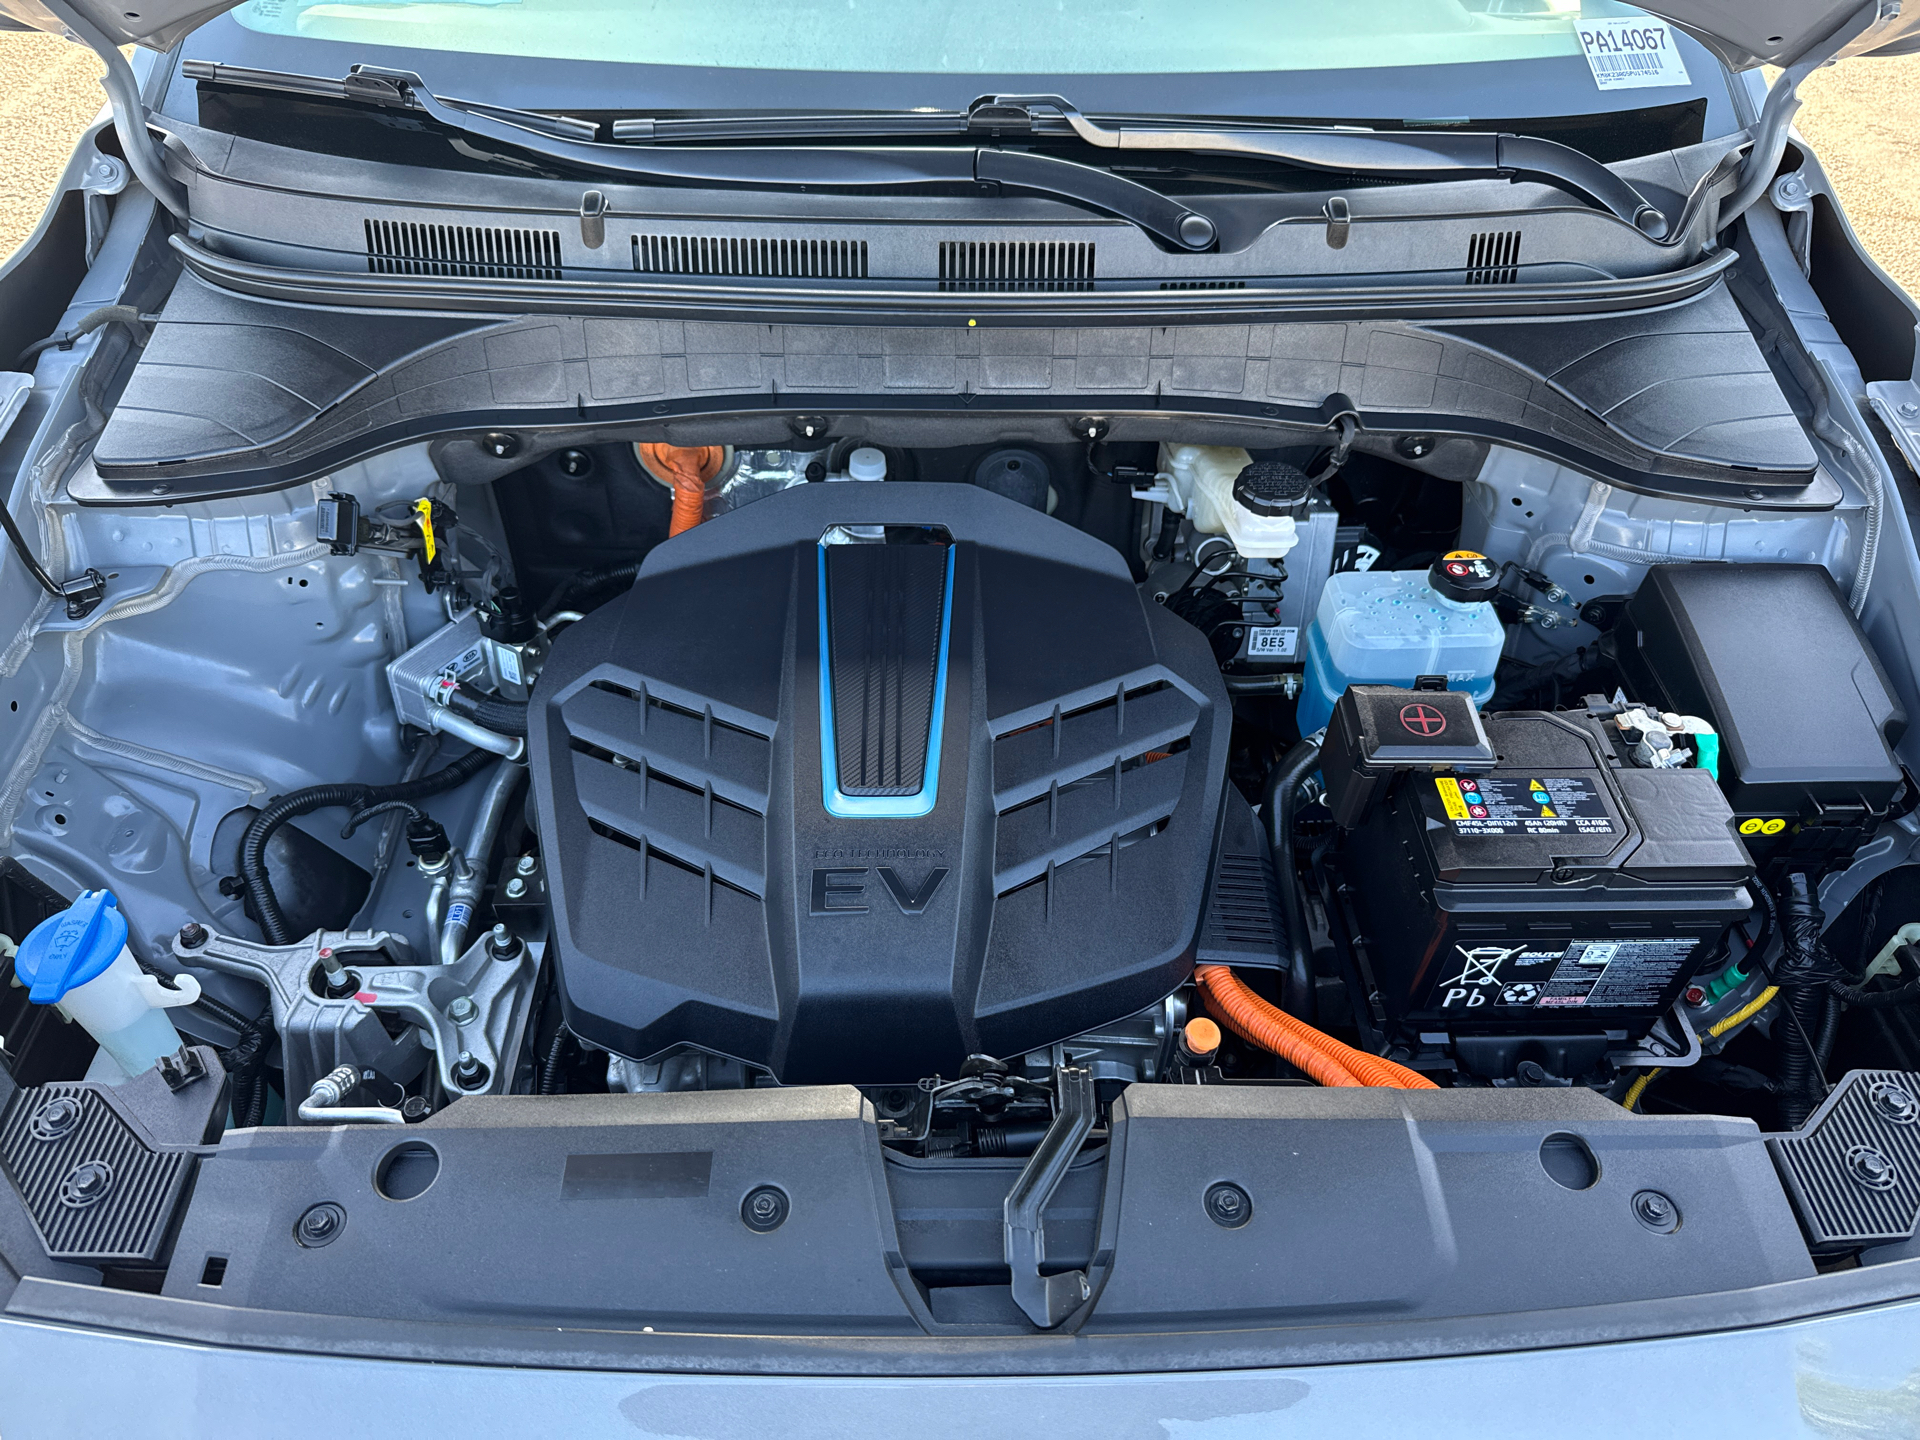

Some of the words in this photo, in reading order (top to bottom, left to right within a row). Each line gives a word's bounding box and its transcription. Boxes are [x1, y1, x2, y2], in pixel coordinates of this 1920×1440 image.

[1580, 28, 1666, 53] PA14067
[1261, 637, 1285, 647] 8E5
[1447, 673, 1475, 682] MAX
[814, 849, 843, 859] ECO
[850, 849, 946, 859] TECHNOLOGY
[809, 867, 950, 916] EV
[1442, 988, 1486, 1007] Pb
